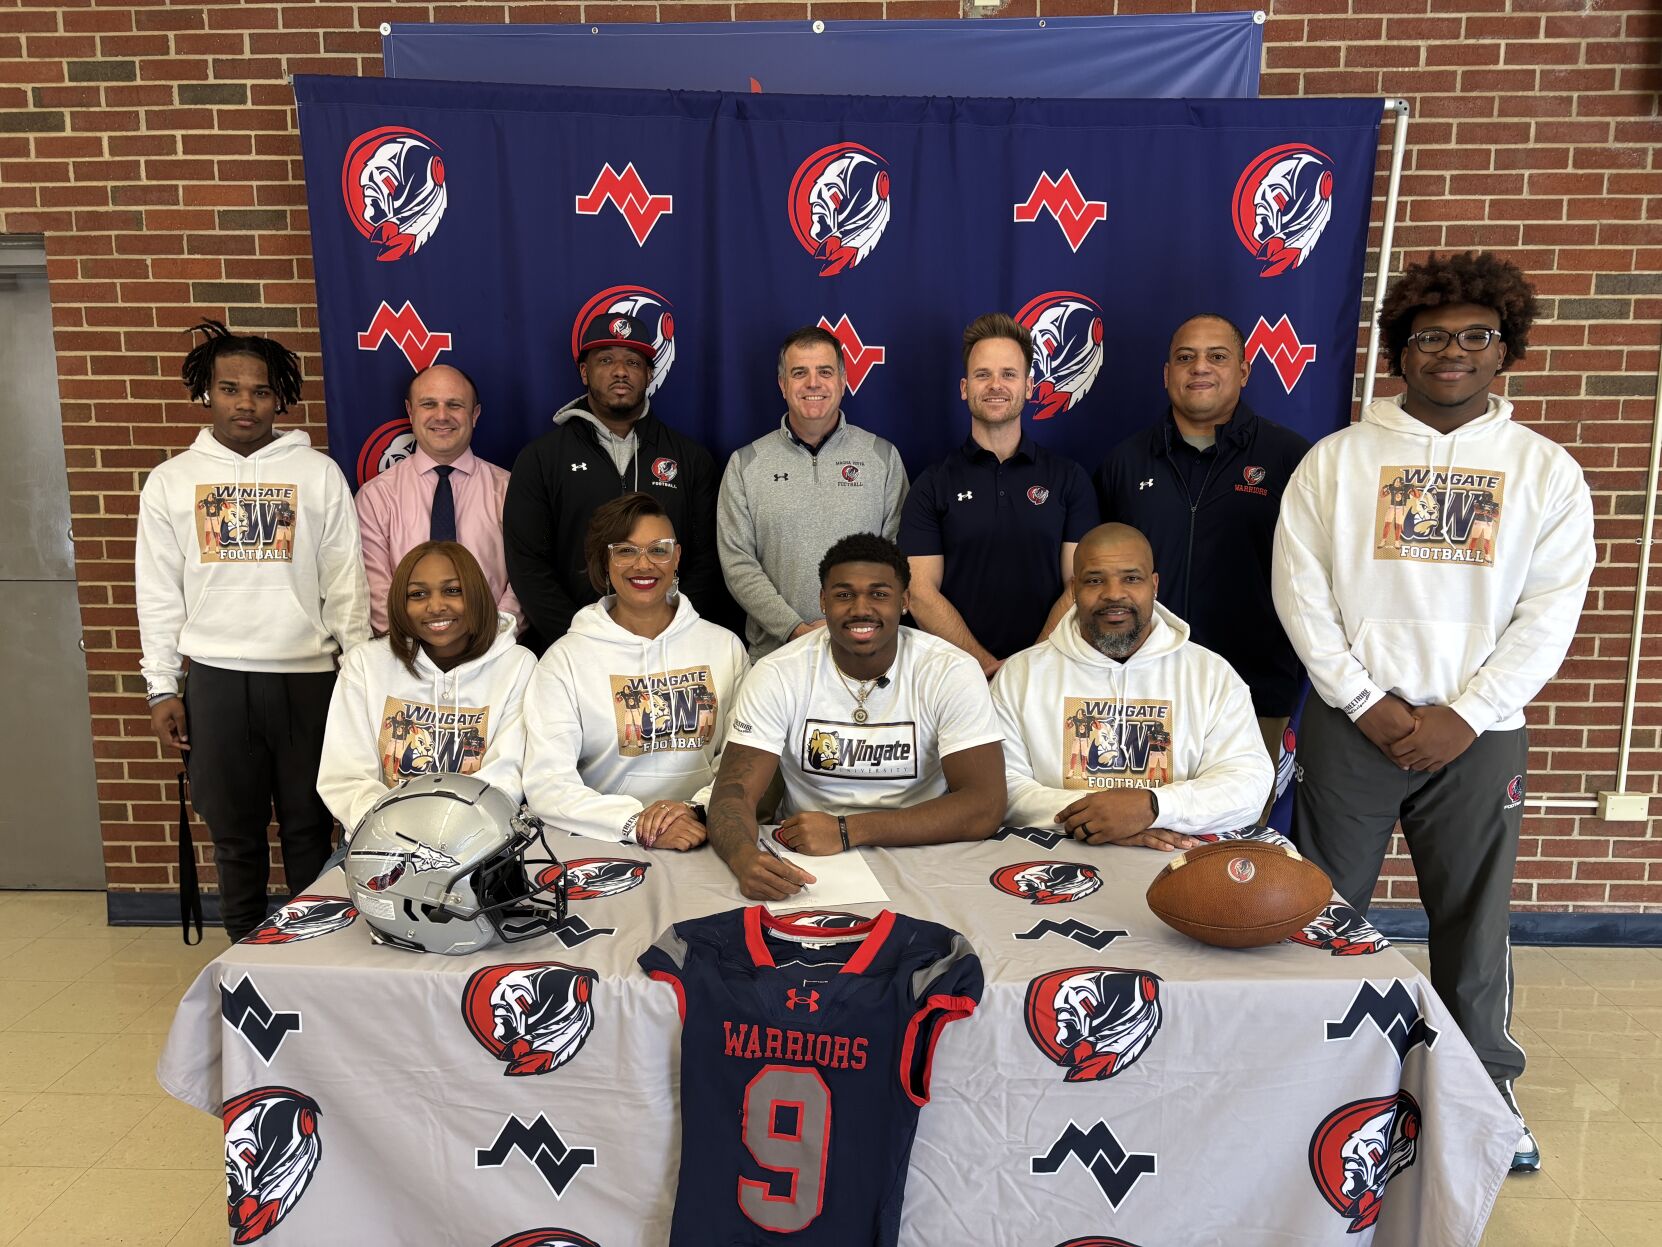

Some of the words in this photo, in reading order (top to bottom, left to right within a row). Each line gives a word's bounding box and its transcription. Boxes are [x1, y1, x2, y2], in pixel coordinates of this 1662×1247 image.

[220, 549, 289, 560] FOOTBALL
[1400, 545, 1484, 563] FOOTBALL
[628, 671, 707, 691] WINGATE
[404, 703, 486, 725] WINGATE
[1084, 701, 1169, 719] WINGATE
[838, 737, 911, 767] Wingate
[723, 1021, 869, 1070] WARRIORS
[737, 1063, 832, 1234] 9
